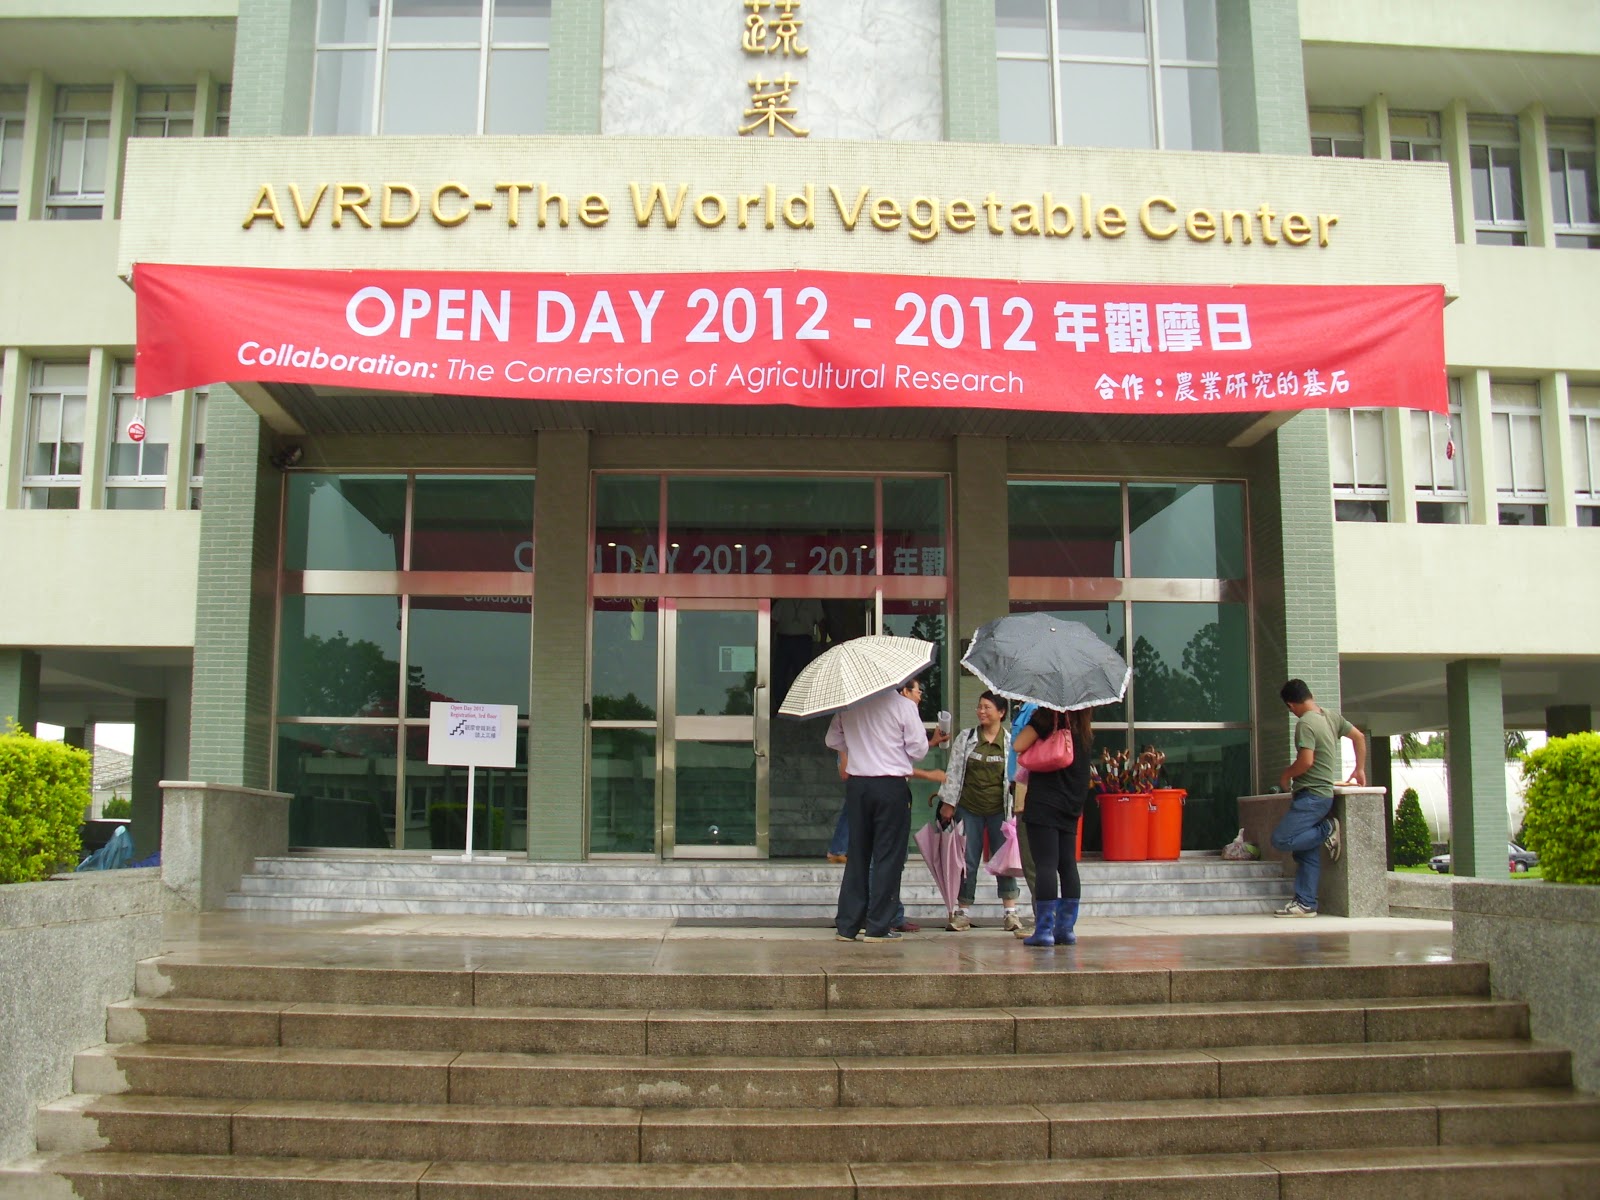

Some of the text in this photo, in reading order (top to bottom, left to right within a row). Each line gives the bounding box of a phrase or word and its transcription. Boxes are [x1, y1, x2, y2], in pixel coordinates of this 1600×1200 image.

[242, 182, 1340, 248] AVRDC-The World Vegetable Center
[345, 285, 511, 343] OPEN
[536, 289, 666, 344] DAY
[685, 286, 830, 344] 2012
[894, 291, 1037, 352] 2012
[1053, 300, 1252, 354] 年觀摩日
[237, 340, 1024, 394] Collaboration: The Cornerstone of Agricultural Research
[692, 543, 773, 575] 2012
